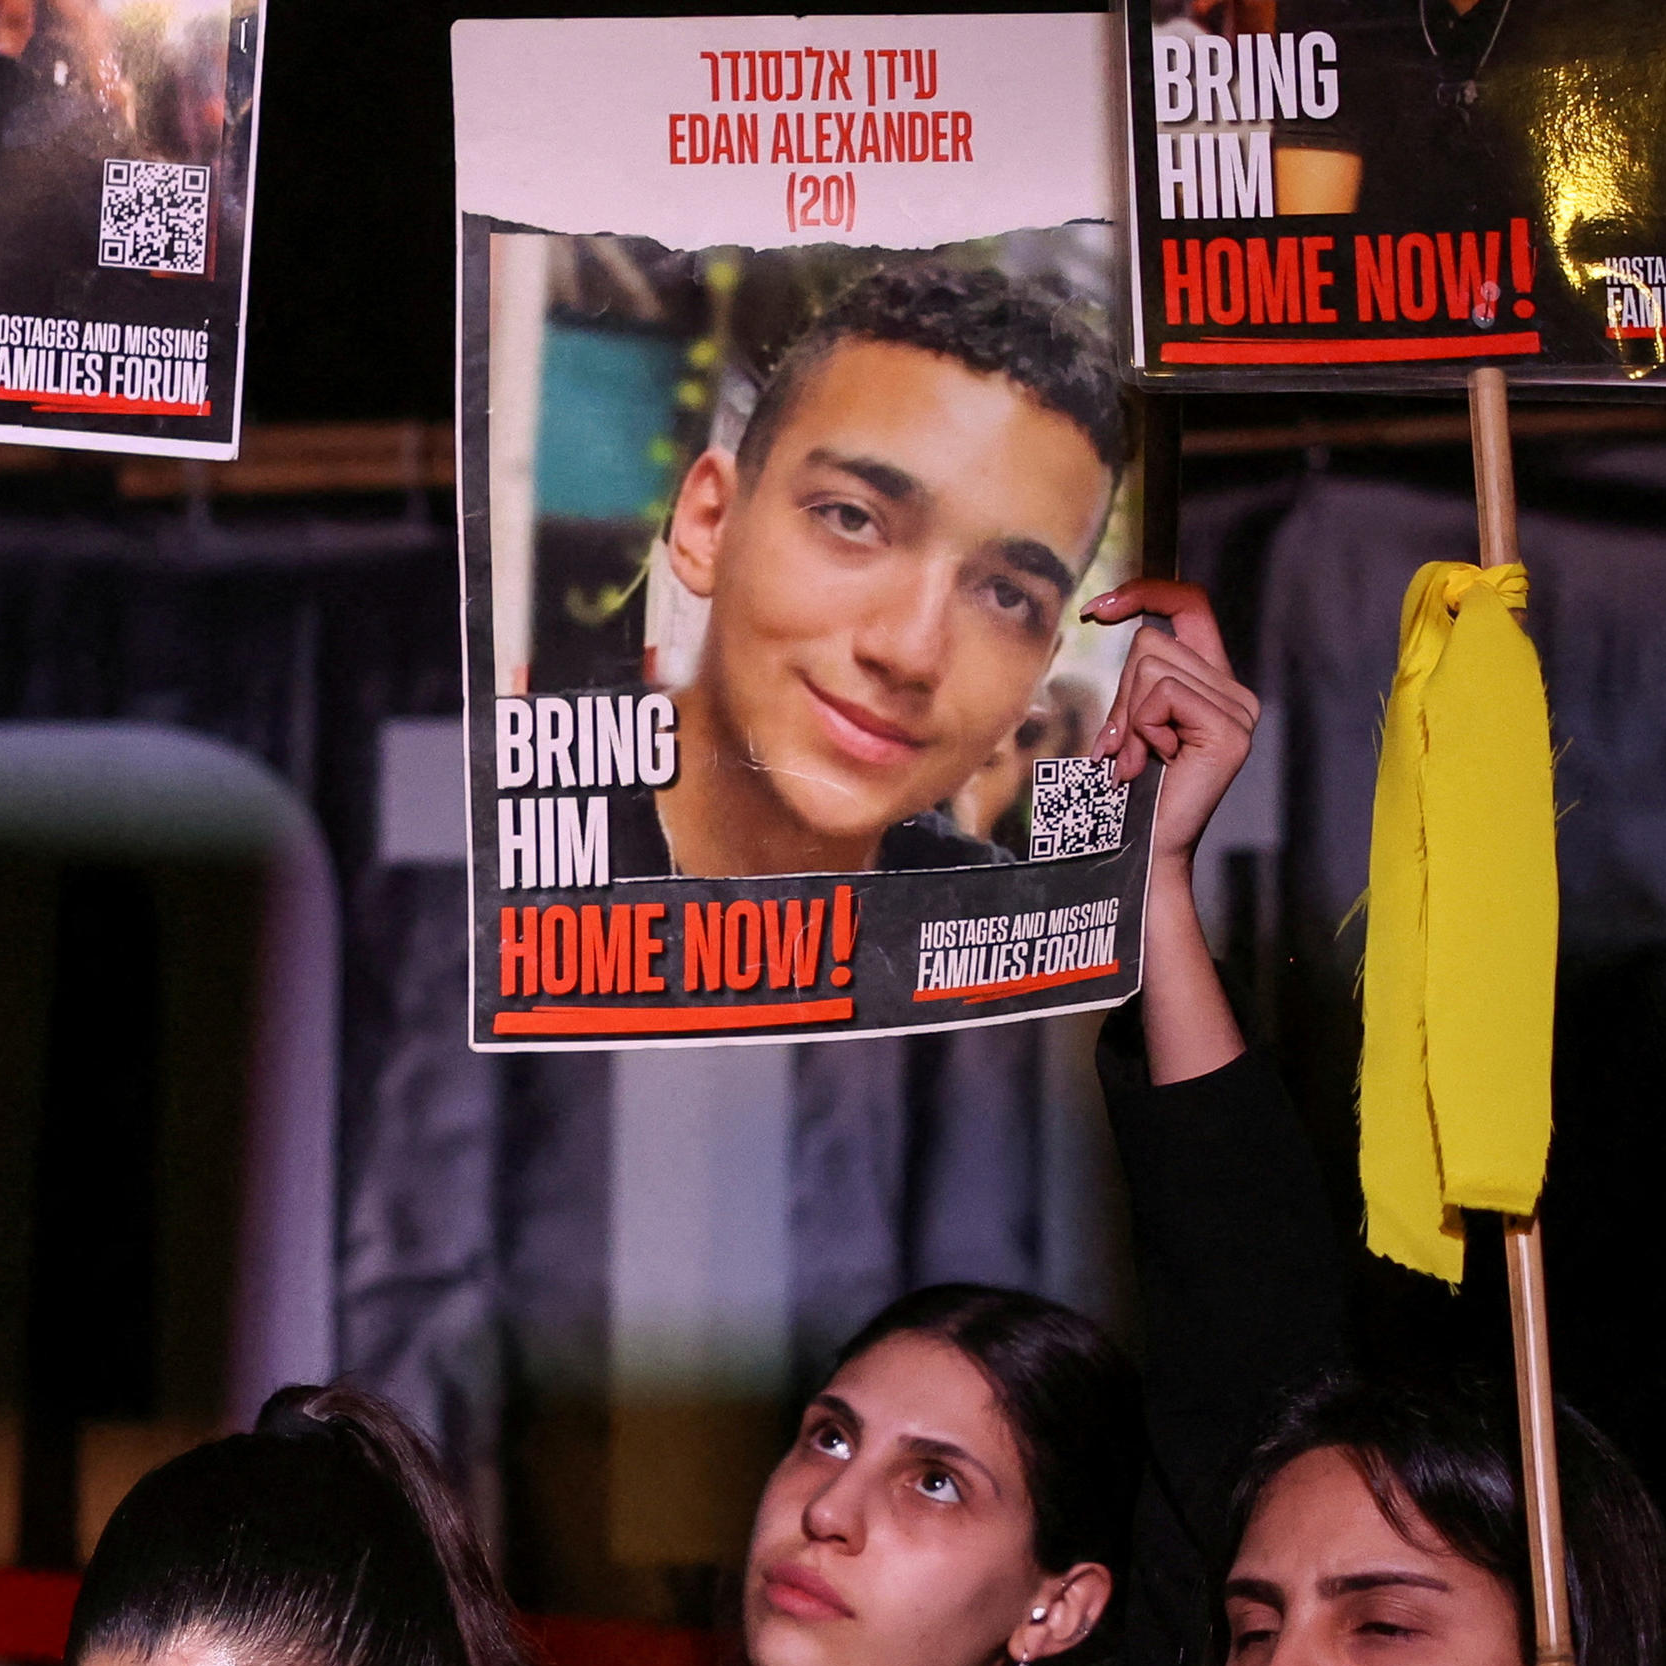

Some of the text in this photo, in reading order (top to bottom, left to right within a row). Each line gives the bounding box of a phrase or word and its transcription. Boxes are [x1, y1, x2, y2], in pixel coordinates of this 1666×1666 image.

[700, 47, 938, 106] עידן אלכסנדר
[1152, 30, 1339, 123] BRING
[669, 110, 973, 165] EDAN ALEXANDER
[786, 171, 856, 232] (20)
[1157, 130, 1275, 220] HIM
[1160, 217, 1536, 327] HOME NOW!
[82, 321, 121, 353] AND
[124, 324, 209, 360] MISSING
[108, 355, 207, 405] FORUM
[496, 693, 676, 789] BRING
[498, 796, 609, 889] HIM
[499, 885, 862, 997] HOME NOW!
[920, 897, 1119, 950] HOSTAGES AND MISSING
[917, 925, 1116, 992] FAMILIES FORUM
